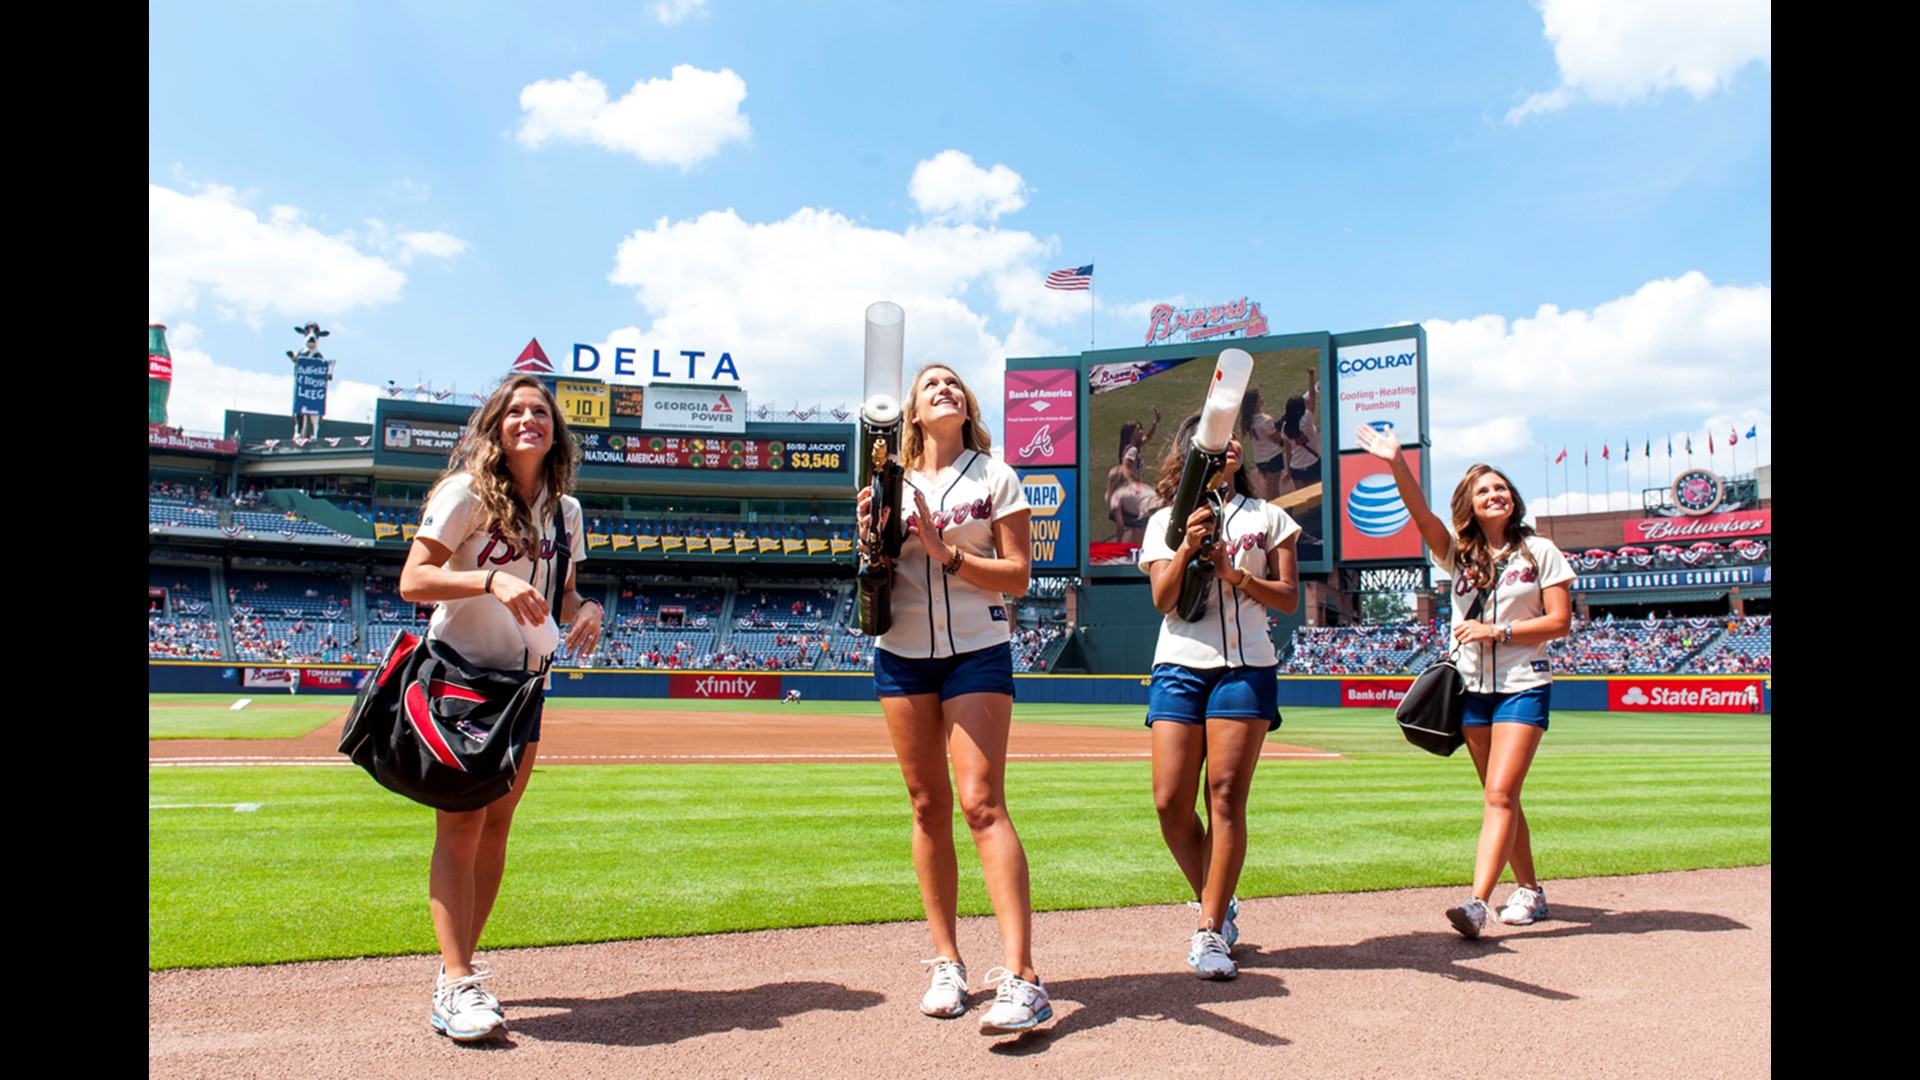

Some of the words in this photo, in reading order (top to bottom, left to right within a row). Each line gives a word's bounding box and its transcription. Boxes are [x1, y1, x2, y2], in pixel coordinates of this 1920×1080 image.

[1146, 297, 1248, 344] Braves
[572, 342, 740, 381] DELTA
[1338, 352, 1417, 374] COOLRAY
[1100, 370, 1133, 384] Braves
[298, 386, 326, 400] LEEG
[1008, 389, 1030, 400] Bank
[1030, 389, 1039, 399] of
[1039, 389, 1073, 399] America
[1339, 390, 1375, 401] Cooling
[1379, 385, 1416, 397] Heating
[654, 401, 709, 412] GEORGIA
[1355, 401, 1400, 412] Plumbing
[691, 413, 733, 423] POWER
[412, 428, 459, 440] DOWNLOAD
[1019, 424, 1054, 458] A
[149, 433, 168, 444] the
[168, 435, 215, 450] Ballpark
[416, 439, 432, 447] THE
[786, 443, 806, 451] 50/50
[808, 443, 847, 452] JACKPOT
[584, 450, 625, 464] NATIONAL
[625, 452, 666, 465] AMERICAN
[791, 452, 840, 470] $3,546
[1024, 486, 1058, 506] NAPA
[1030, 520, 1061, 541] NOW
[1637, 517, 1766, 541] Budweiser
[1030, 541, 1056, 562] OW
[1605, 576, 1620, 588] IS
[1627, 573, 1678, 588] BRAVES
[1686, 569, 1749, 585] COUNTRY
[251, 668, 287, 682] Braves
[306, 669, 354, 678] TOMAHAWK
[568, 672, 584, 680] 380
[319, 677, 342, 685] TEAM
[694, 675, 757, 698] xfinity
[1348, 689, 1374, 700] Bank
[1375, 689, 1387, 700] of
